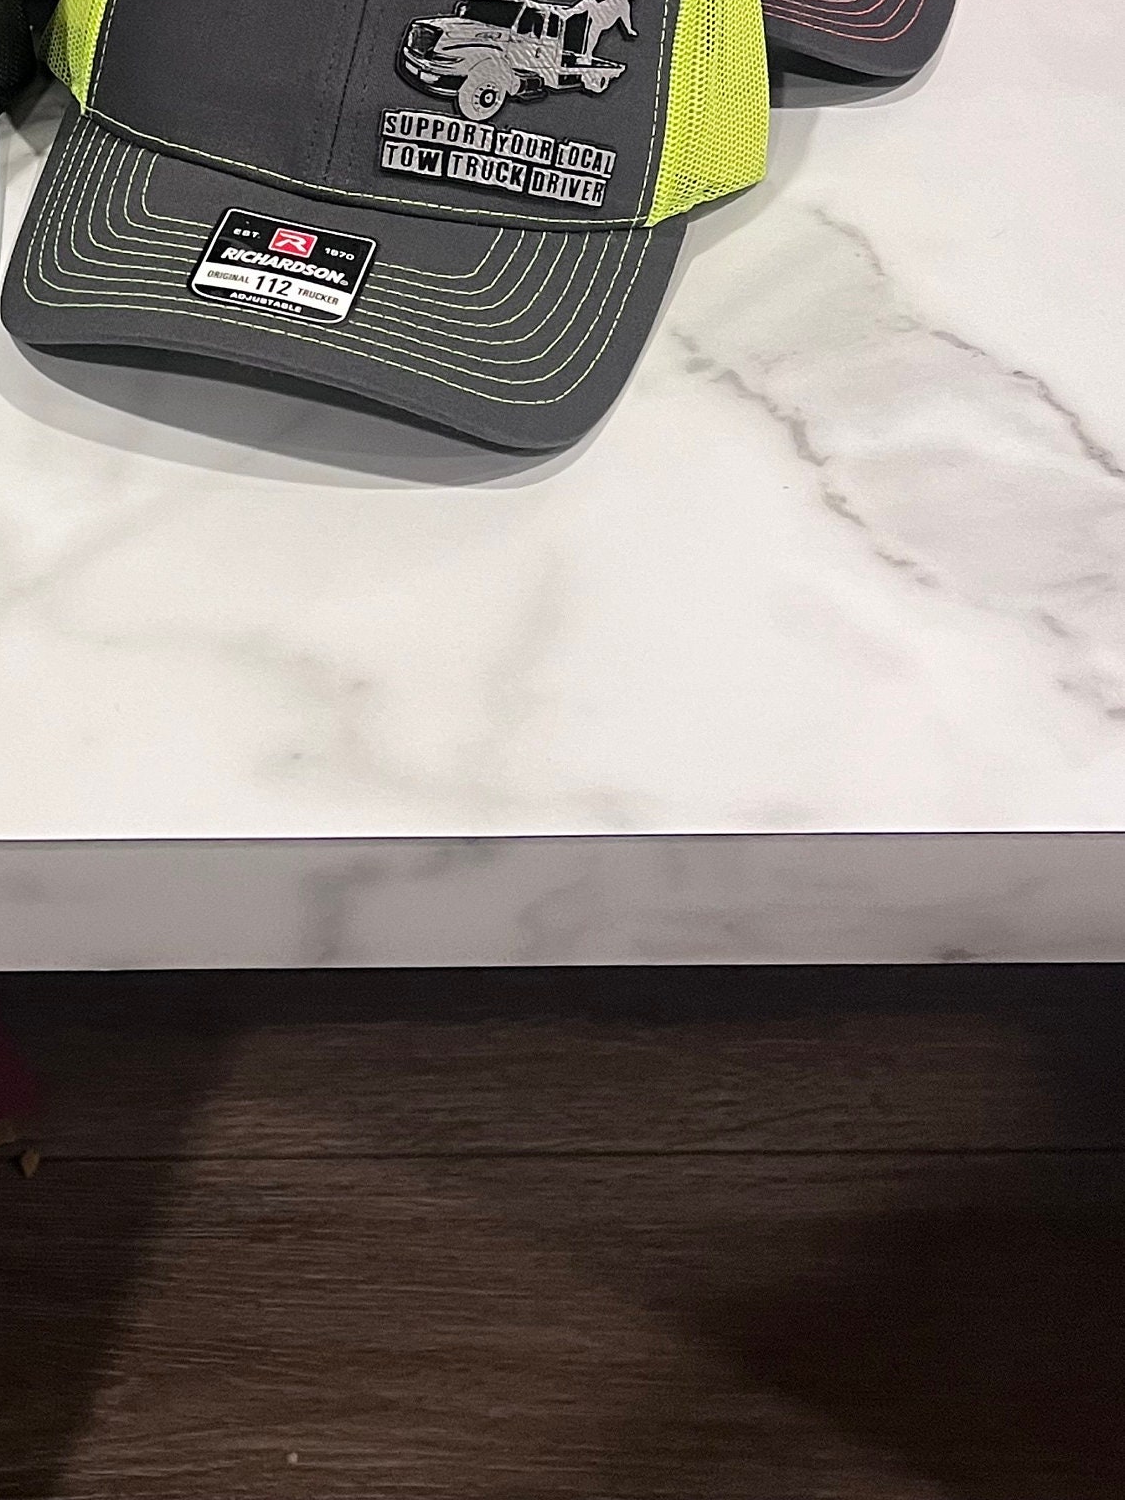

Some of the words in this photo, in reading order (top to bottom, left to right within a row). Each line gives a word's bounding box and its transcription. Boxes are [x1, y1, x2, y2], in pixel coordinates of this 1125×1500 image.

[386, 115, 492, 149] SUPPORT
[499, 132, 552, 162] YOUR
[558, 143, 614, 176] LOCAL
[386, 144, 440, 172] TOW
[452, 154, 523, 187] TRUCK
[532, 170, 605, 203] DRIVER
[221, 247, 345, 284] RICHARDSON
[325, 247, 355, 261] 1970
[207, 270, 250, 284] ORIGINAL
[255, 276, 293, 296] 112
[298, 287, 339, 305] TRUCKER
[230, 291, 302, 313] ADJUSTABLE
